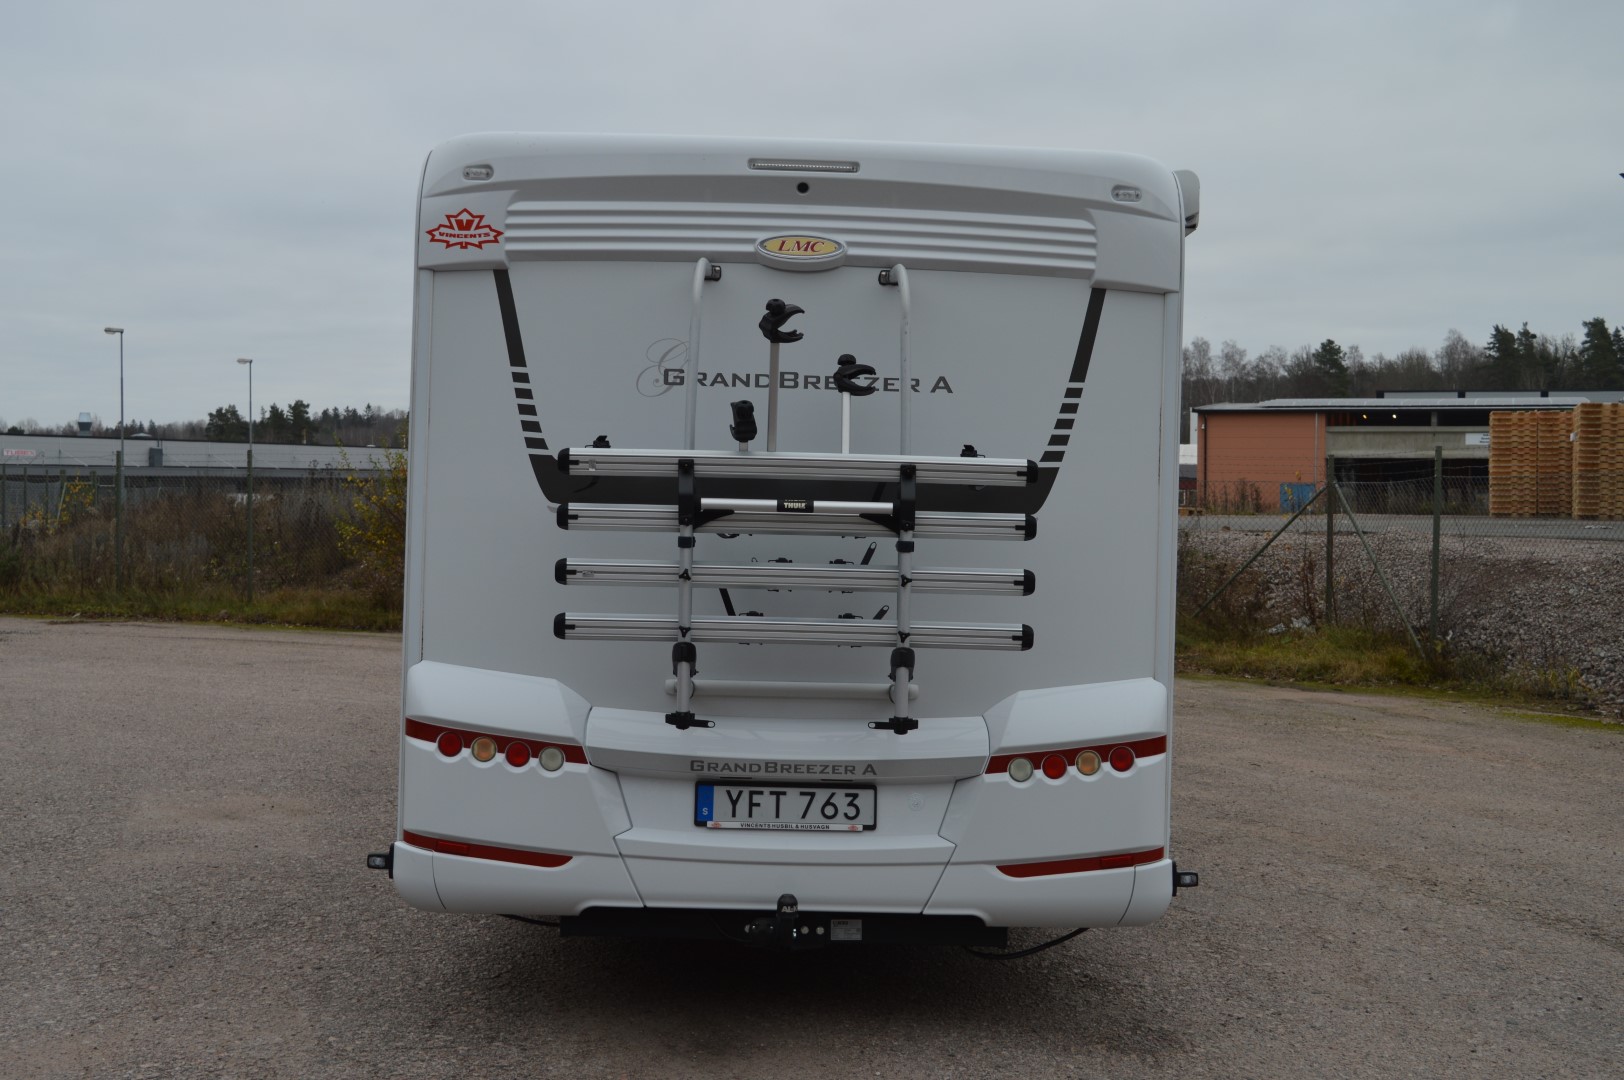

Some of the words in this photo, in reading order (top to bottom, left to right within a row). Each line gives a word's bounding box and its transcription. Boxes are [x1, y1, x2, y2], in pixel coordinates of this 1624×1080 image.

[439, 231, 491, 239] VINCENTS
[778, 239, 825, 253] LMC
[663, 368, 921, 393] GRANDBREZER
[930, 375, 954, 394] A
[862, 763, 878, 776] A
[702, 807, 709, 816] S
[725, 789, 788, 819] YFT
[799, 791, 861, 821] 763
